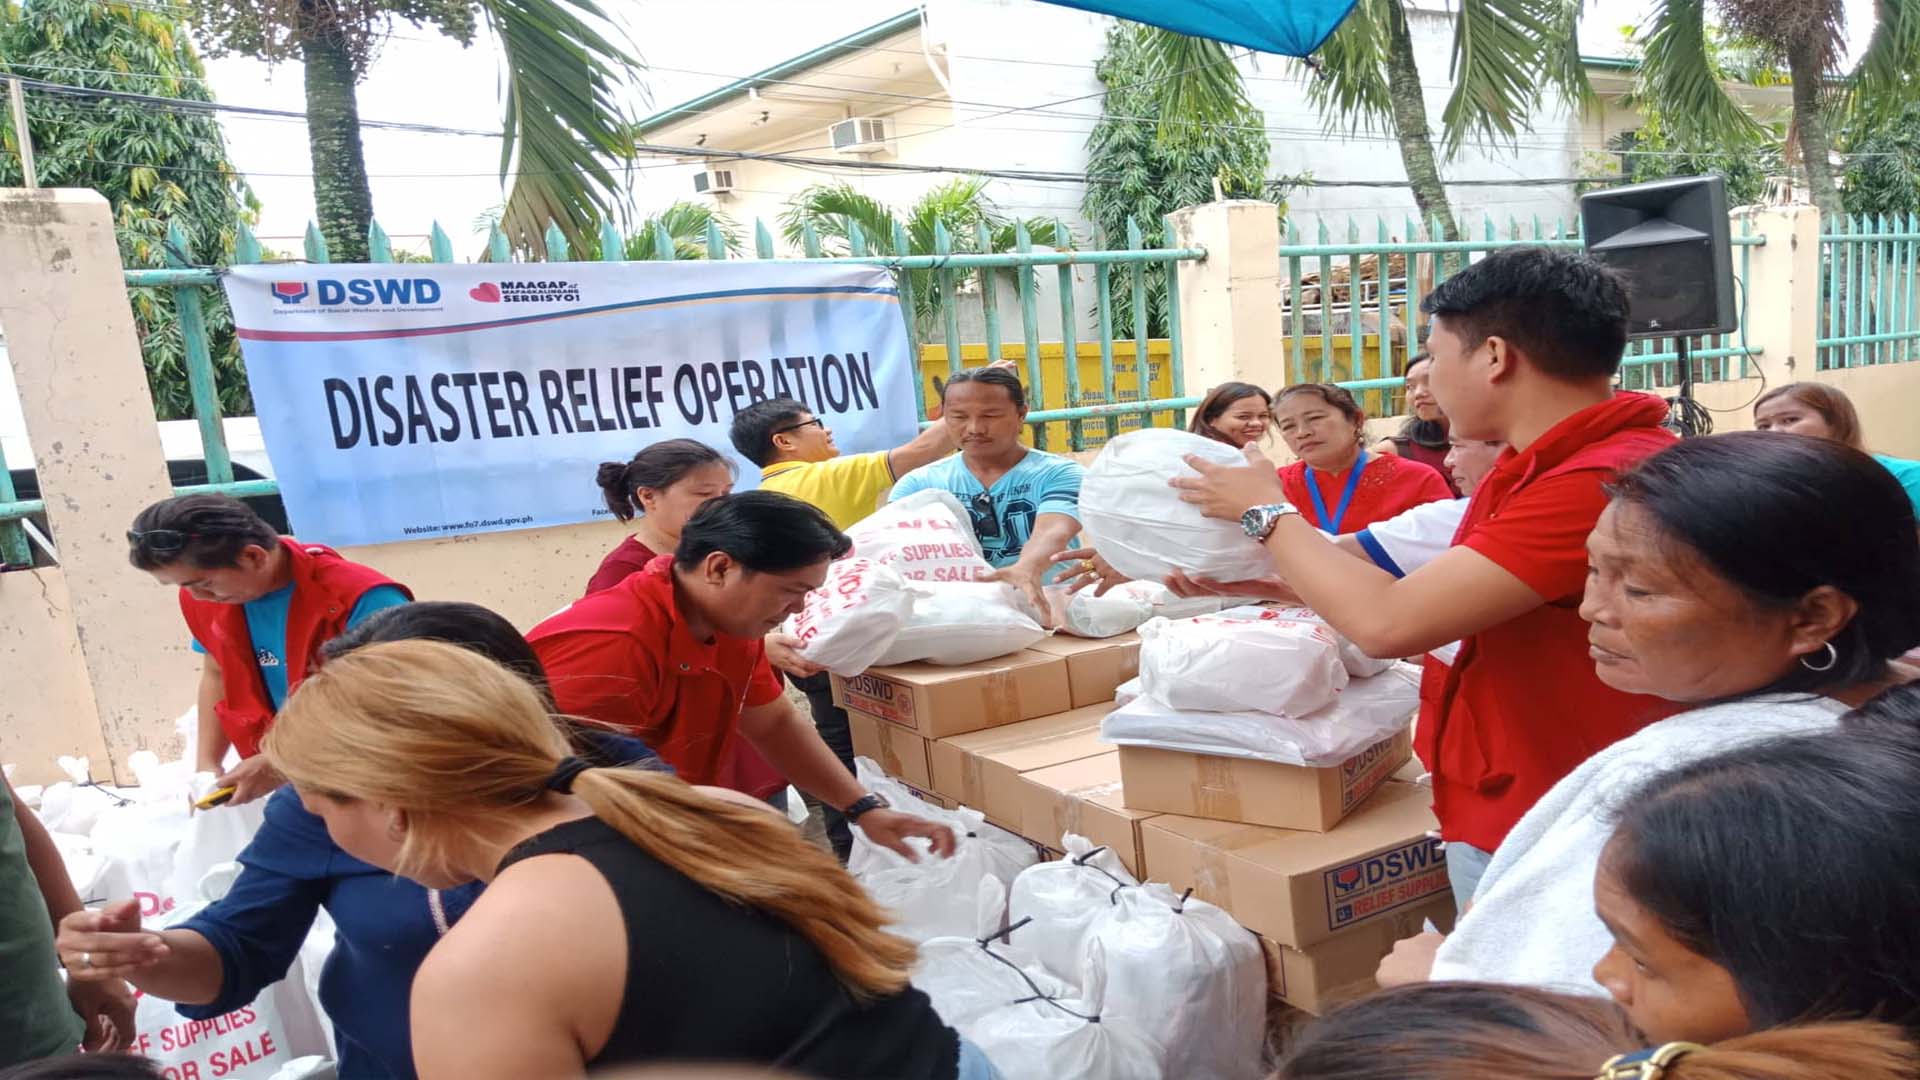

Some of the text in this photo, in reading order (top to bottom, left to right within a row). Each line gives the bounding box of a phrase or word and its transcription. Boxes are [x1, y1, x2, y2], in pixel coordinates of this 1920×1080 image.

[317, 279, 441, 306] DSWD
[500, 281, 567, 290] MAAGAP
[323, 351, 880, 450] DISASTER RELIEF OPERATION
[403, 524, 442, 536] Website:
[901, 542, 974, 562] SUPPLIES
[854, 675, 893, 701] DSWD
[1366, 839, 1447, 885] DSWD
[1353, 887, 1395, 917] RELIEF
[159, 1004, 257, 1052] SUPPLIES
[208, 1030, 277, 1077] SALE
